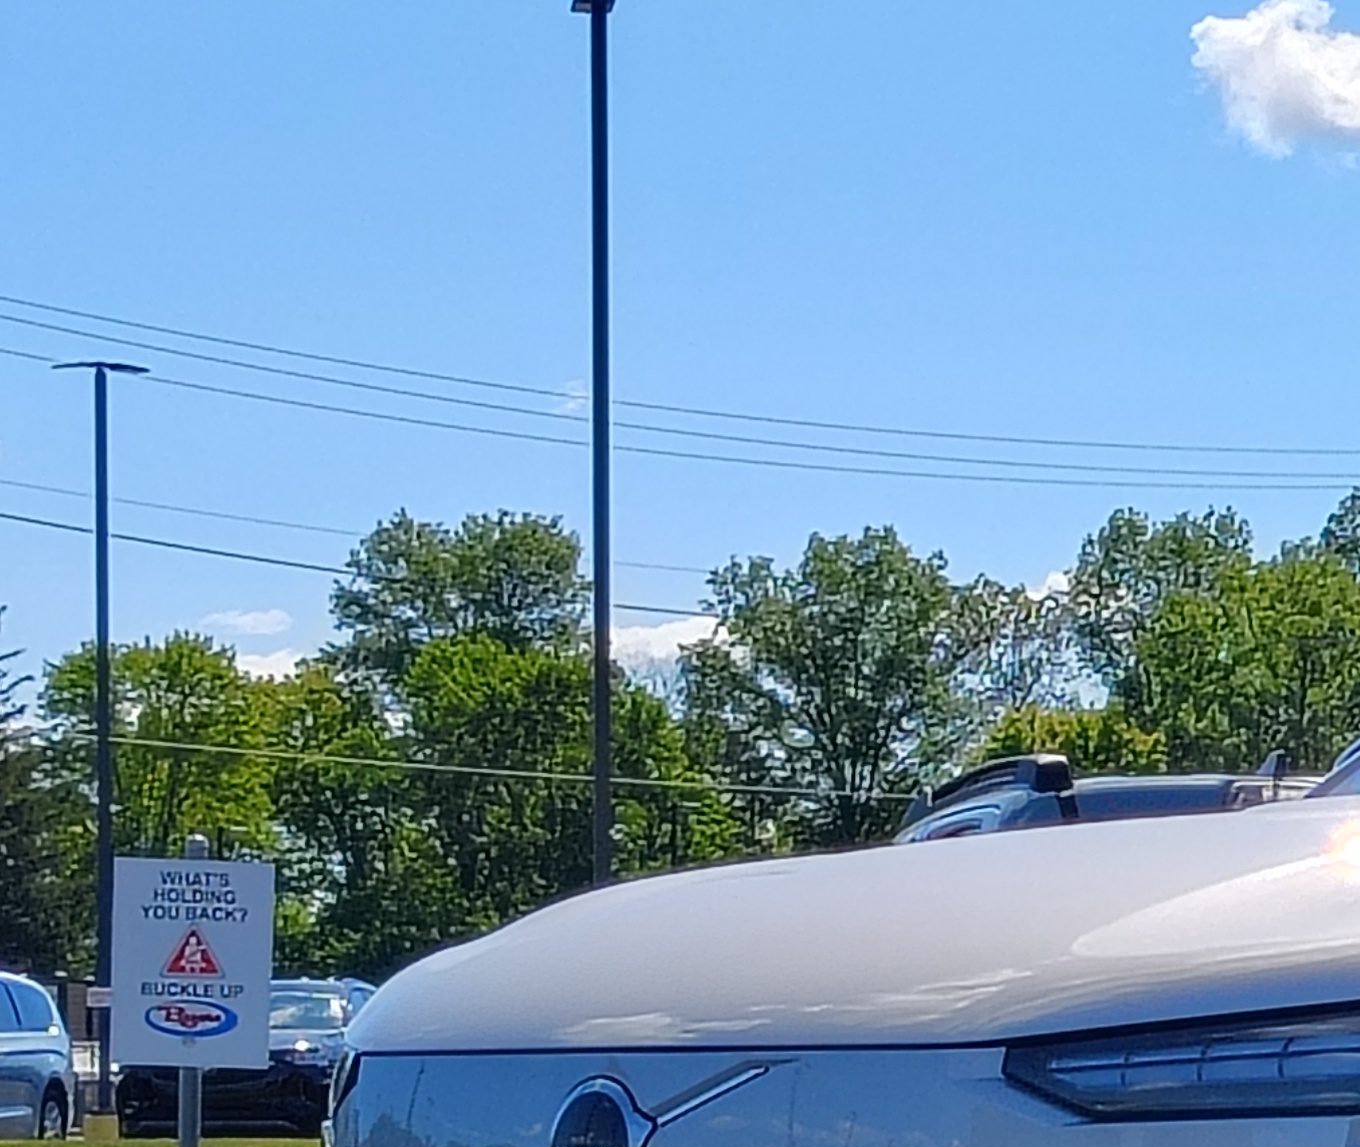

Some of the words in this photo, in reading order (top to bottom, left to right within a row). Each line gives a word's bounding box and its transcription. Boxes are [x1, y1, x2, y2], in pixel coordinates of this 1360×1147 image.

[161, 871, 229, 887] WHAT'S
[154, 889, 236, 904] HOLDING
[141, 905, 179, 919] YOU
[185, 906, 248, 922] BACK?
[141, 983, 214, 998] BUCKLE
[220, 985, 244, 998] UP
